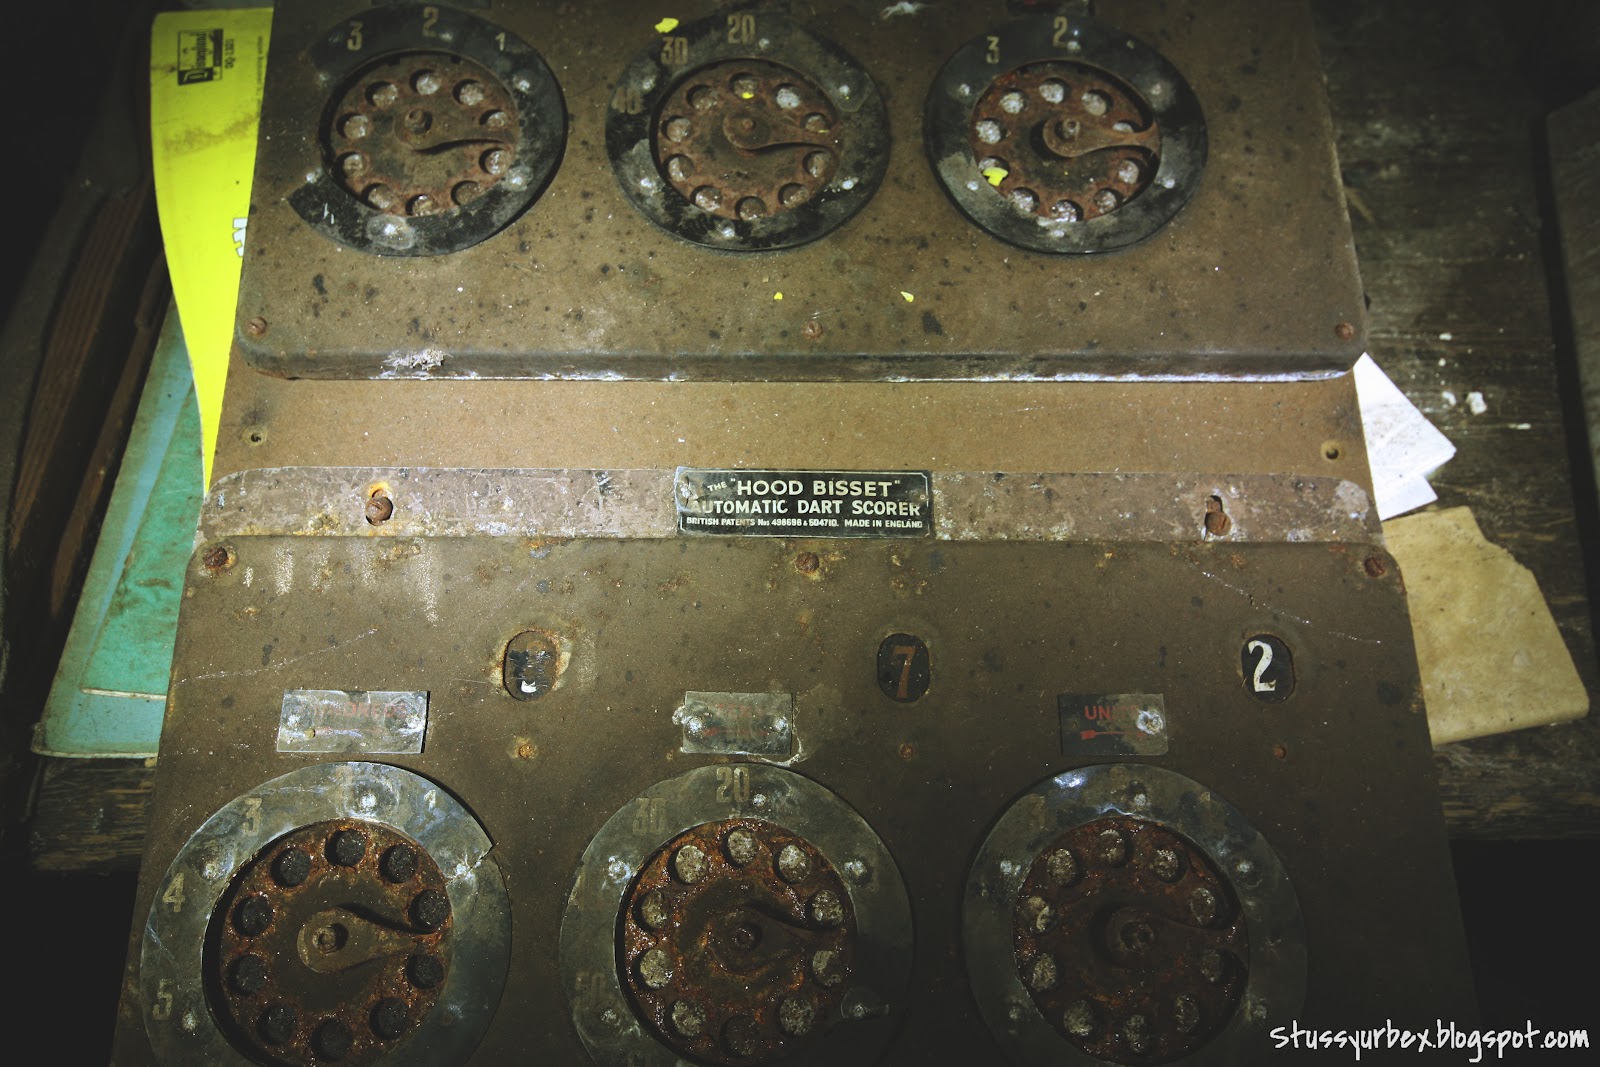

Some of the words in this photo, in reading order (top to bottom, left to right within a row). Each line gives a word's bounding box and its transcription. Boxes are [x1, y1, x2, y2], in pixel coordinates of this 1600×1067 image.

[347, 22, 362, 50] 3
[423, 6, 439, 37] 2
[727, 14, 755, 44] 20
[1053, 16, 1068, 47] 2
[495, 31, 506, 51] 1
[661, 36, 688, 65] 30
[986, 36, 999, 64] 3
[707, 480, 729, 492] THE
[686, 517, 719, 526] BRITISH
[721, 518, 756, 526] PATENTS
[844, 518, 870, 527] MADE
[872, 519, 882, 527] IN
[885, 519, 923, 529] ENGLAND
[797, 499, 843, 514] DART
[852, 500, 920, 517] SCORER
[892, 645, 916, 698] 7
[1247, 639, 1277, 692] 2
[424, 789, 437, 809] 1
[716, 766, 750, 802] 20
[243, 797, 262, 836] 3
[162, 872, 186, 912] 4
[152, 978, 174, 1020] 5
